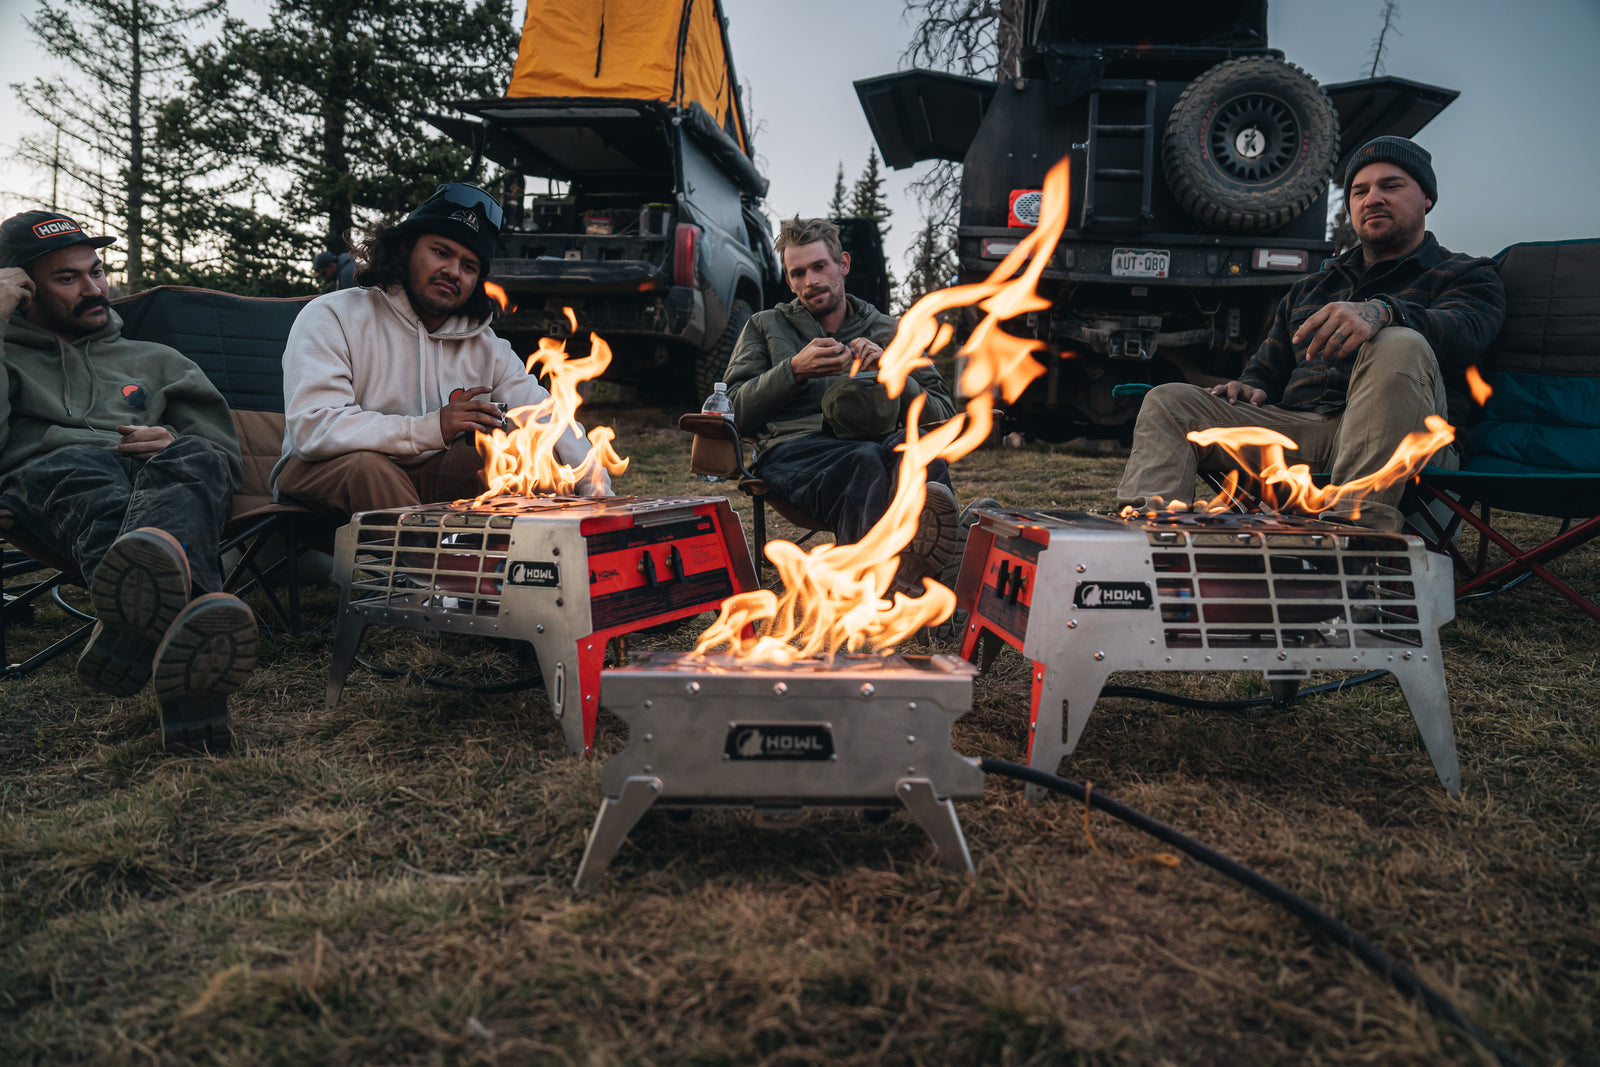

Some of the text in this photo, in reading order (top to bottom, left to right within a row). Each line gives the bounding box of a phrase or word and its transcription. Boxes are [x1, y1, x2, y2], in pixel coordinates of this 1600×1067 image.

[38, 221, 76, 236] HOWL
[526, 568, 555, 580] HOWL
[1103, 589, 1146, 601] HOWL
[765, 735, 823, 750] HOWL
